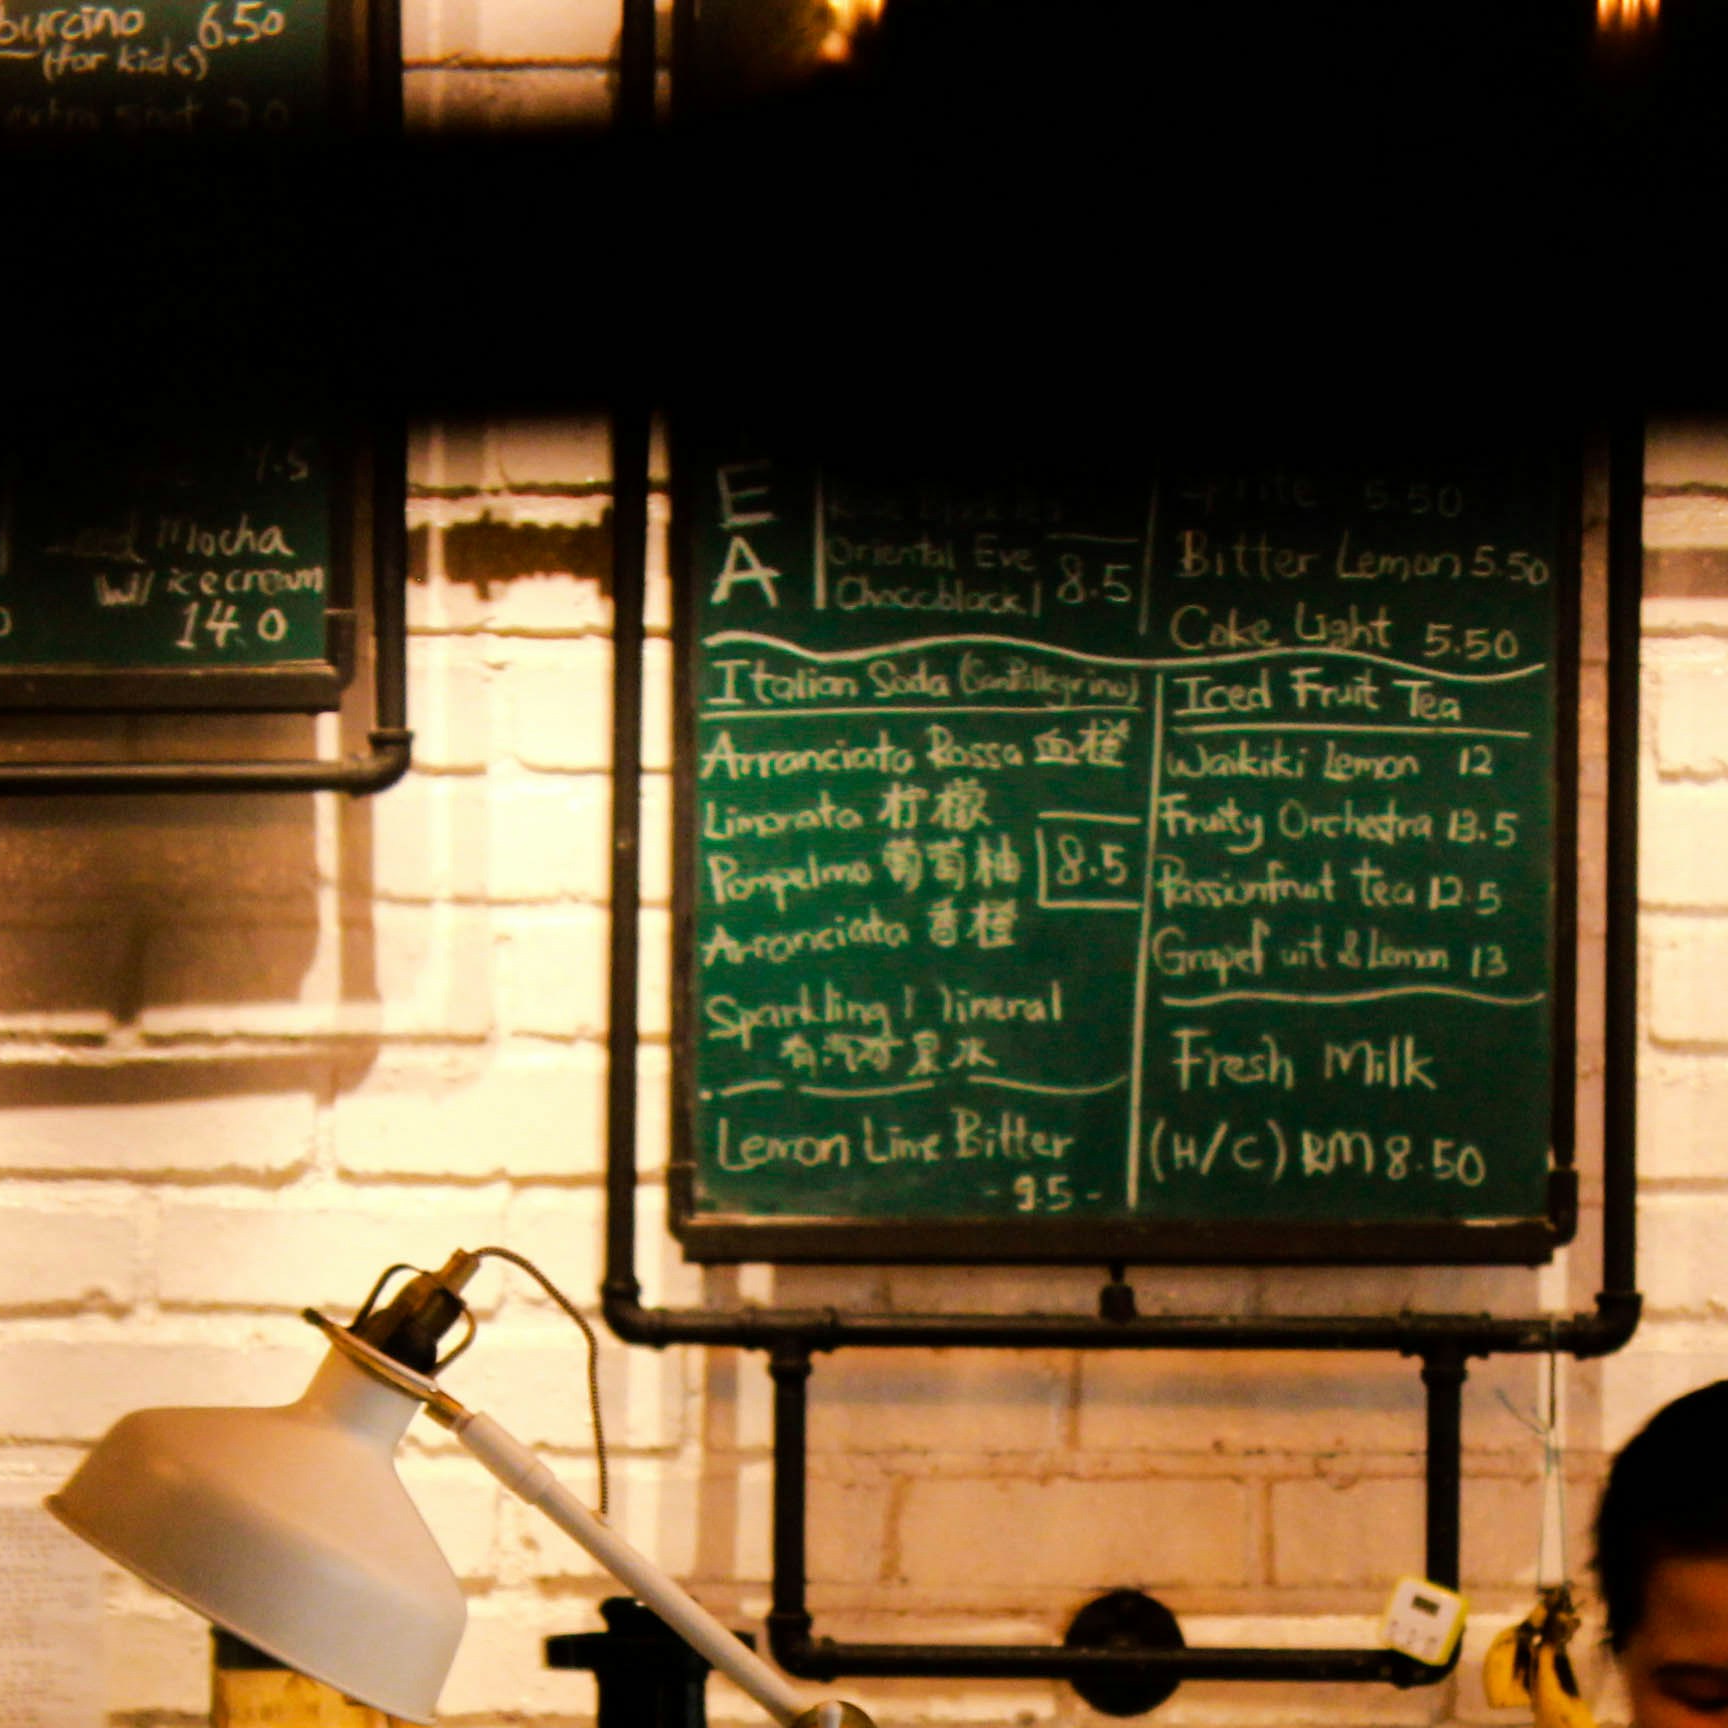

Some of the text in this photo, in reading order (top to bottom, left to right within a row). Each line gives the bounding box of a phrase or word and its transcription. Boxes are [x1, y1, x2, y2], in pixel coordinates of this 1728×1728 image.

[197, 0, 286, 50] 6.50
[155, 512, 298, 558] Mocha
[973, 531, 1037, 572] Eve
[1175, 527, 1550, 586] Bitter Lemon 5.50
[1056, 552, 1133, 606] 8.5
[1169, 600, 1521, 662] Coke Light 5.50
[706, 658, 859, 706] Italian
[870, 659, 951, 698] Soda
[1172, 665, 1462, 722] Iced Fruit Tea
[927, 724, 1024, 770] Rossa
[1167, 737, 1494, 781] Waikiki Lemon 12
[1159, 792, 1521, 856] Fruity Orchestra 13.5
[707, 849, 872, 913] Pompelmo
[1056, 833, 1130, 888] 8.5
[1367, 927, 1450, 971] Lemon
[1470, 944, 1510, 980] 13
[706, 979, 893, 1052] Sparkling
[1170, 1025, 1438, 1093] Fresh Milk
[718, 1116, 851, 1174] Lemon
[949, 1106, 1075, 1161] Bitter
